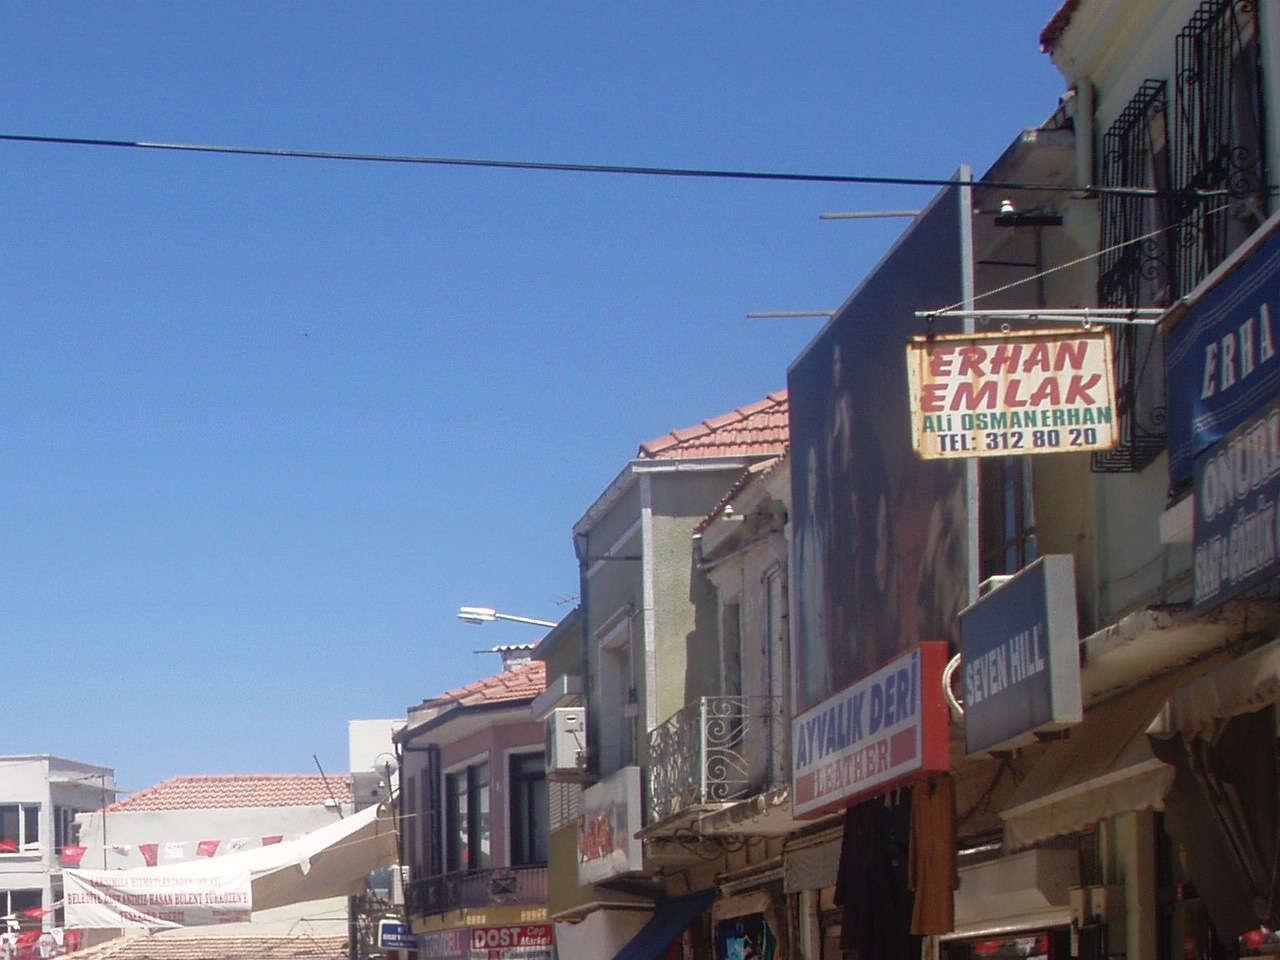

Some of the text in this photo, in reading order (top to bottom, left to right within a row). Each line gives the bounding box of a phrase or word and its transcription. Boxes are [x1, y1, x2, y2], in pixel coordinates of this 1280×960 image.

[930, 341, 1089, 378] ERHAN
[920, 373, 1102, 413] EMLAK
[961, 411, 1038, 431] OSMAN
[1041, 407, 1112, 428] ERHAN
[938, 427, 1097, 452] TEL: 312 80 20
[965, 623, 1045, 707] SEVEN HILL
[796, 651, 919, 771] AYVALIK DERİ
[814, 738, 891, 799] LEATHER
[149, 893, 174, 906] HASAN
[175, 892, 202, 905] BÜLENT
[475, 928, 520, 948] DOST
[520, 936, 551, 947] Market
